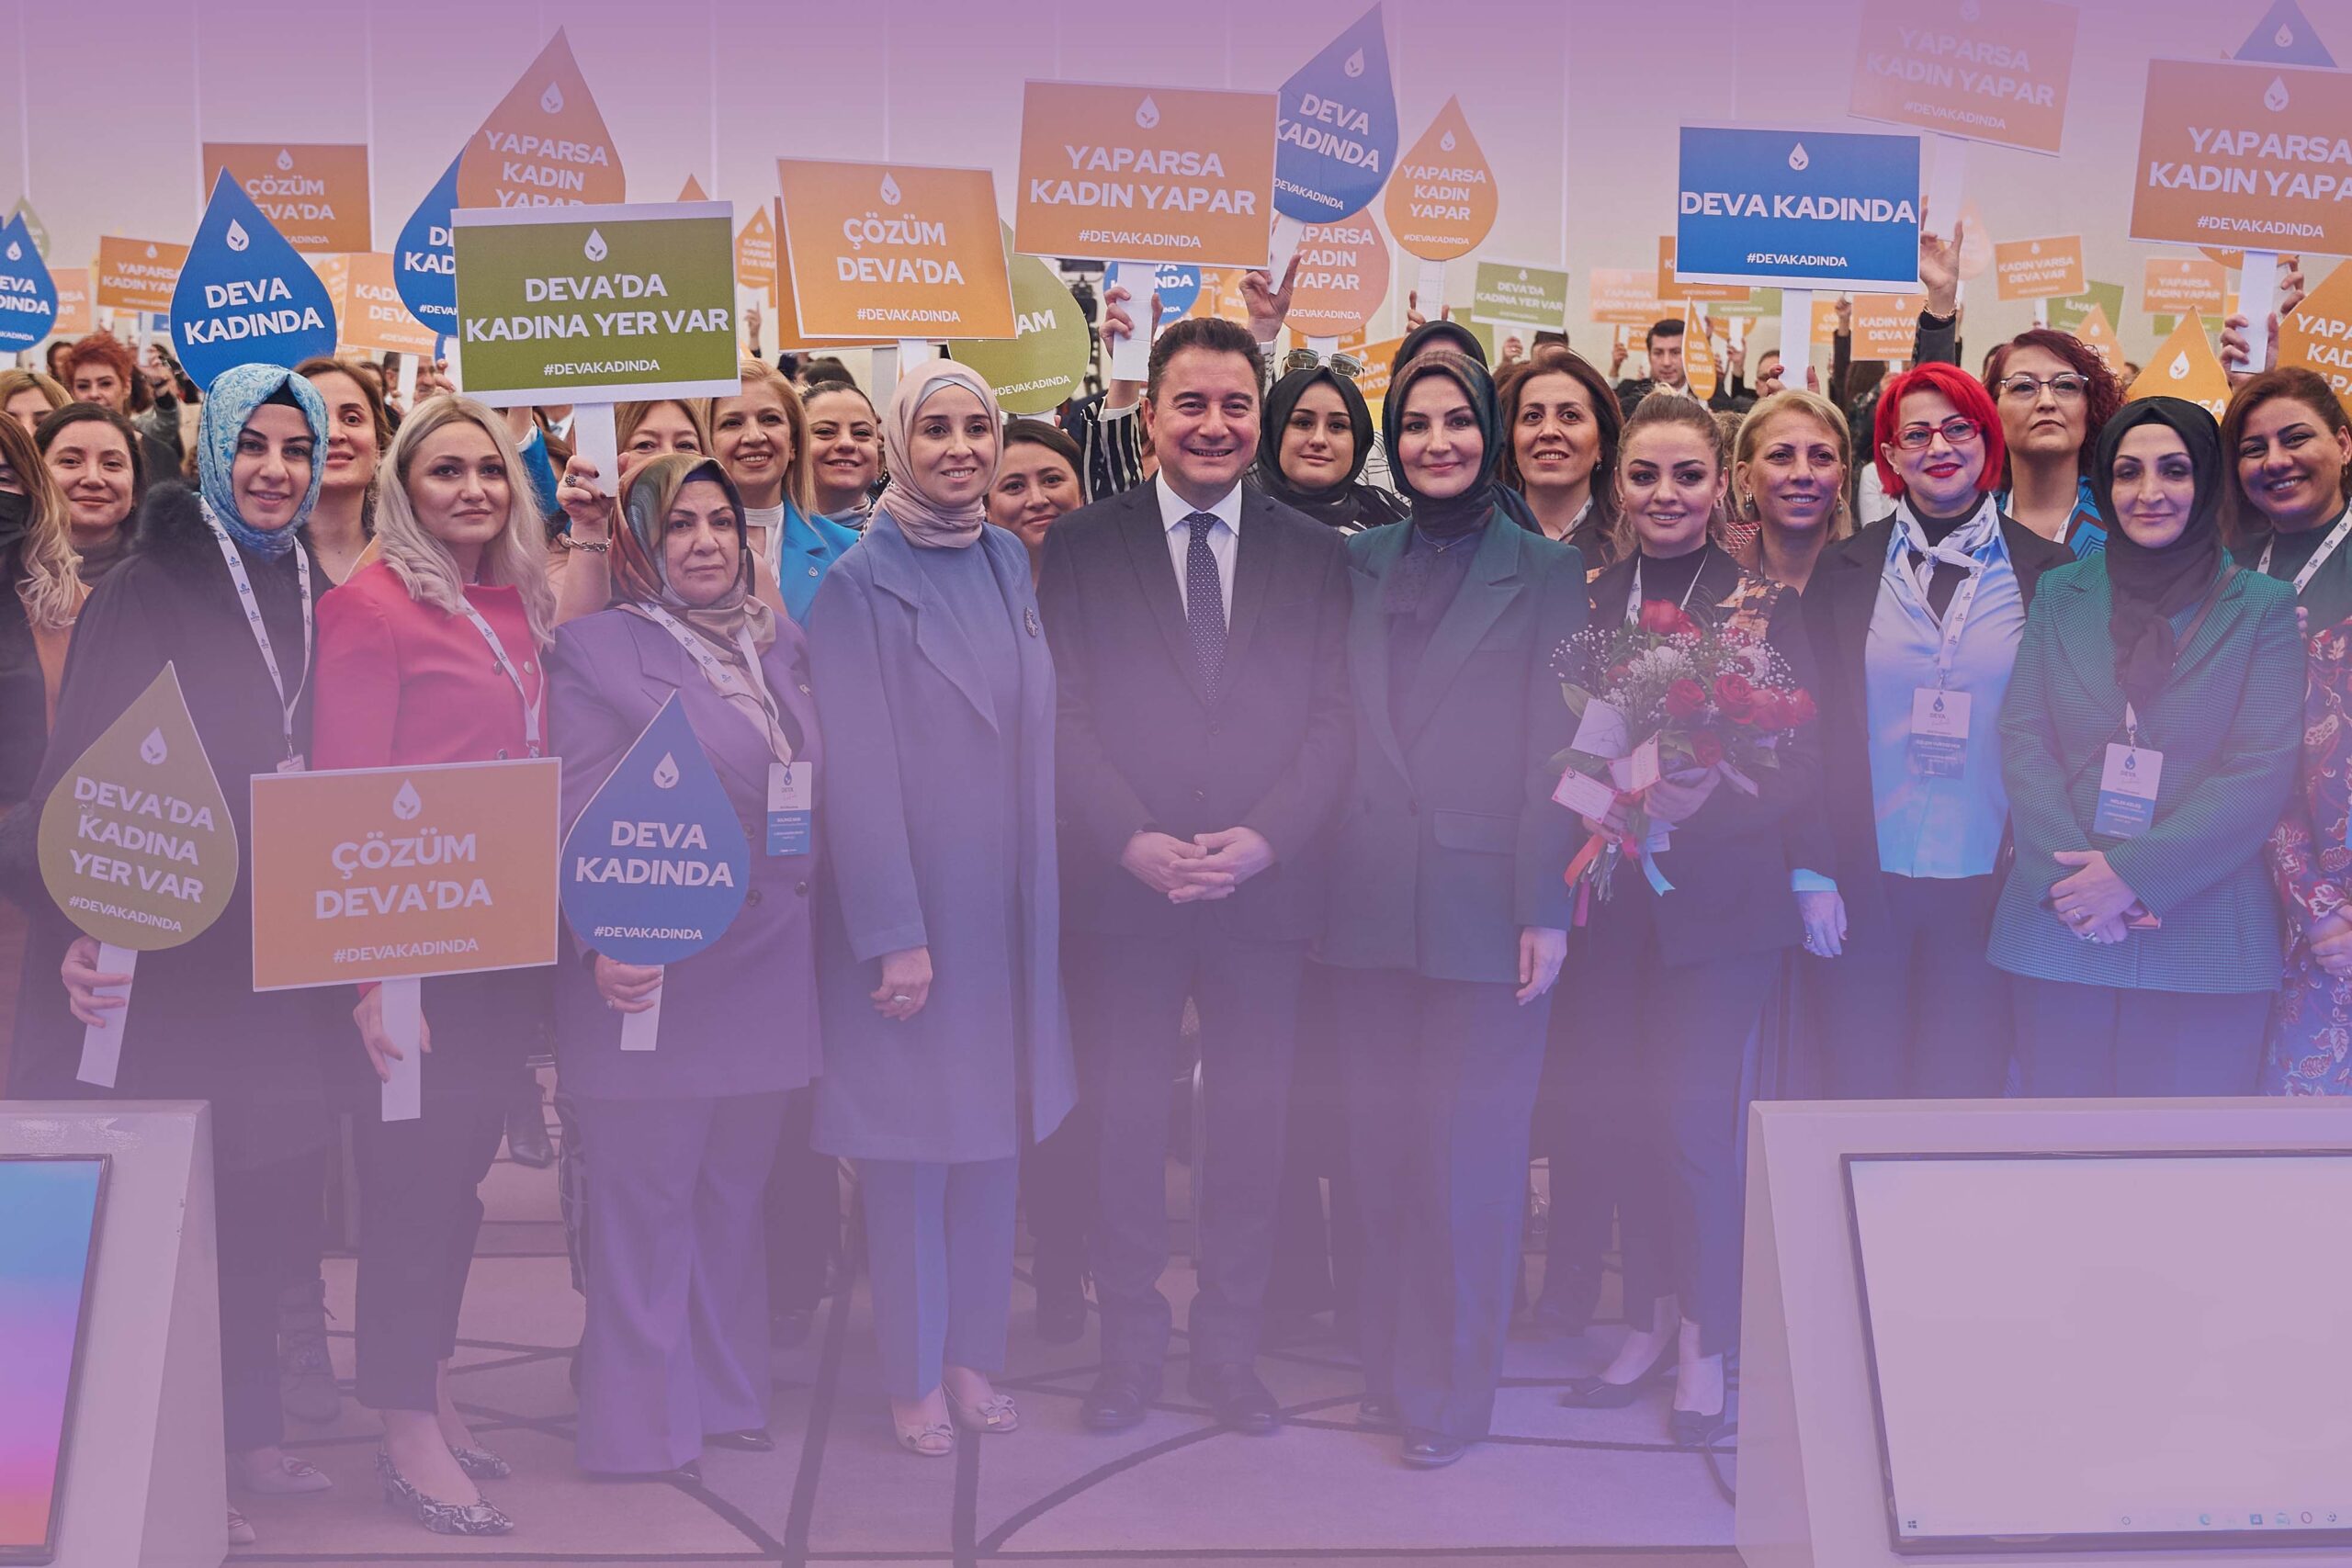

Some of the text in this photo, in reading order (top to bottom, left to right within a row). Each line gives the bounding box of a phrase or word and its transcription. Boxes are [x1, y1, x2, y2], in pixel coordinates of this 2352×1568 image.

[1898, 27, 2030, 73] YAPARSA
[1866, 52, 2055, 107] KADIN YAPAR
[1299, 93, 1369, 135] DEVA
[1904, 101, 2006, 130] #DEVAKADINDA
[484, 130, 608, 167] YAPARSA
[1065, 144, 1225, 177] YAPARSA
[2188, 127, 2352, 164] YAPARSA
[245, 175, 324, 199] ÇÖZÜM
[503, 162, 584, 191] KADIN
[1402, 164, 1487, 184] YAPARSA
[2148, 161, 2352, 201] KADIN YAPA
[1030, 178, 1255, 215] KADIN YAPAR
[1274, 177, 1344, 210] DEVAKADINDA
[1414, 185, 1470, 202] KADIN
[1680, 191, 1917, 224] DEVA KADINDA
[259, 205, 335, 220] EVA'DA
[1410, 203, 1470, 220] YAPAR
[2198, 215, 2324, 238] #DEVAKADINDA
[842, 211, 947, 250] ÇÖZÜM
[1079, 229, 1202, 248] #DEVAKADINDA
[1301, 226, 1374, 245] PARSA
[1403, 233, 1469, 246] #DEVAKADINDA
[837, 256, 965, 286] DEVA'DA
[1747, 253, 1848, 267] #DEVAKADINDA
[0, 276, 37, 294] EVA
[204, 277, 292, 309] DEVA
[525, 274, 668, 302] DEVA'DA
[0, 294, 51, 315] DINDA
[856, 308, 961, 323] #DEVAKADINDA
[1519, 298, 1541, 309] YER
[1541, 299, 1564, 311] VAR
[184, 307, 324, 345] KADINDA
[466, 309, 729, 343] KADINA YER VAR
[543, 359, 661, 376] #DEVAKADINDA
[74, 776, 215, 832] DEVA'DA
[78, 814, 198, 865] KADINA
[611, 821, 707, 850] DEVA
[332, 828, 476, 880] ÇÖZÜM
[70, 849, 204, 903] YER VAR
[575, 857, 734, 887] KADINDA
[316, 878, 492, 919] DEVA'DA
[68, 896, 183, 932] #DEVAKADINDA
[594, 926, 703, 940] #DEVAKADINDA
[333, 938, 479, 963] #DEVAKADINDA
